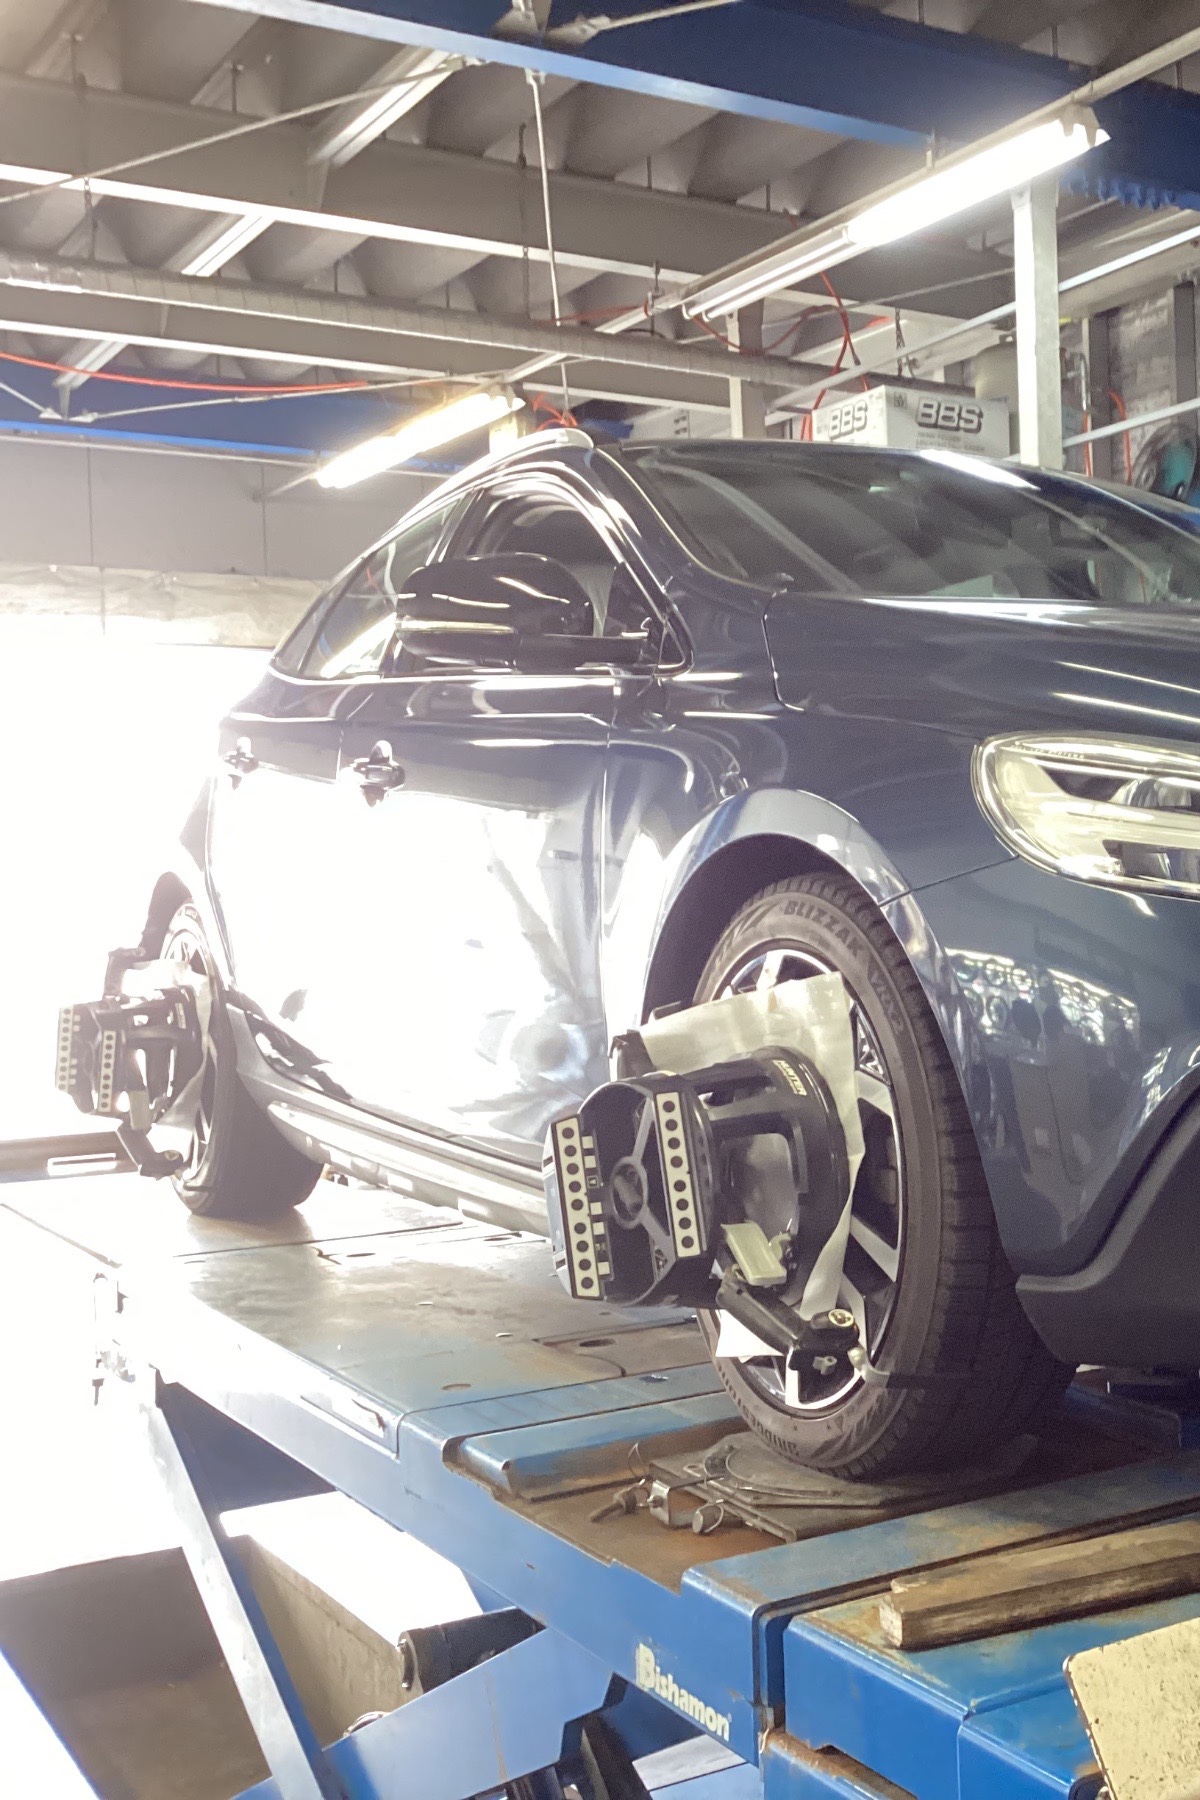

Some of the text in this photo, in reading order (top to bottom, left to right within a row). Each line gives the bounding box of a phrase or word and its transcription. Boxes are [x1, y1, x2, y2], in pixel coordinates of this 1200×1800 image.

[828, 399, 868, 440] BBS
[916, 396, 984, 434] BBS
[784, 900, 866, 958] BLIZZAK
[775, 1059, 808, 1096] HUNTER
[635, 1642, 731, 1742] Bishamon
